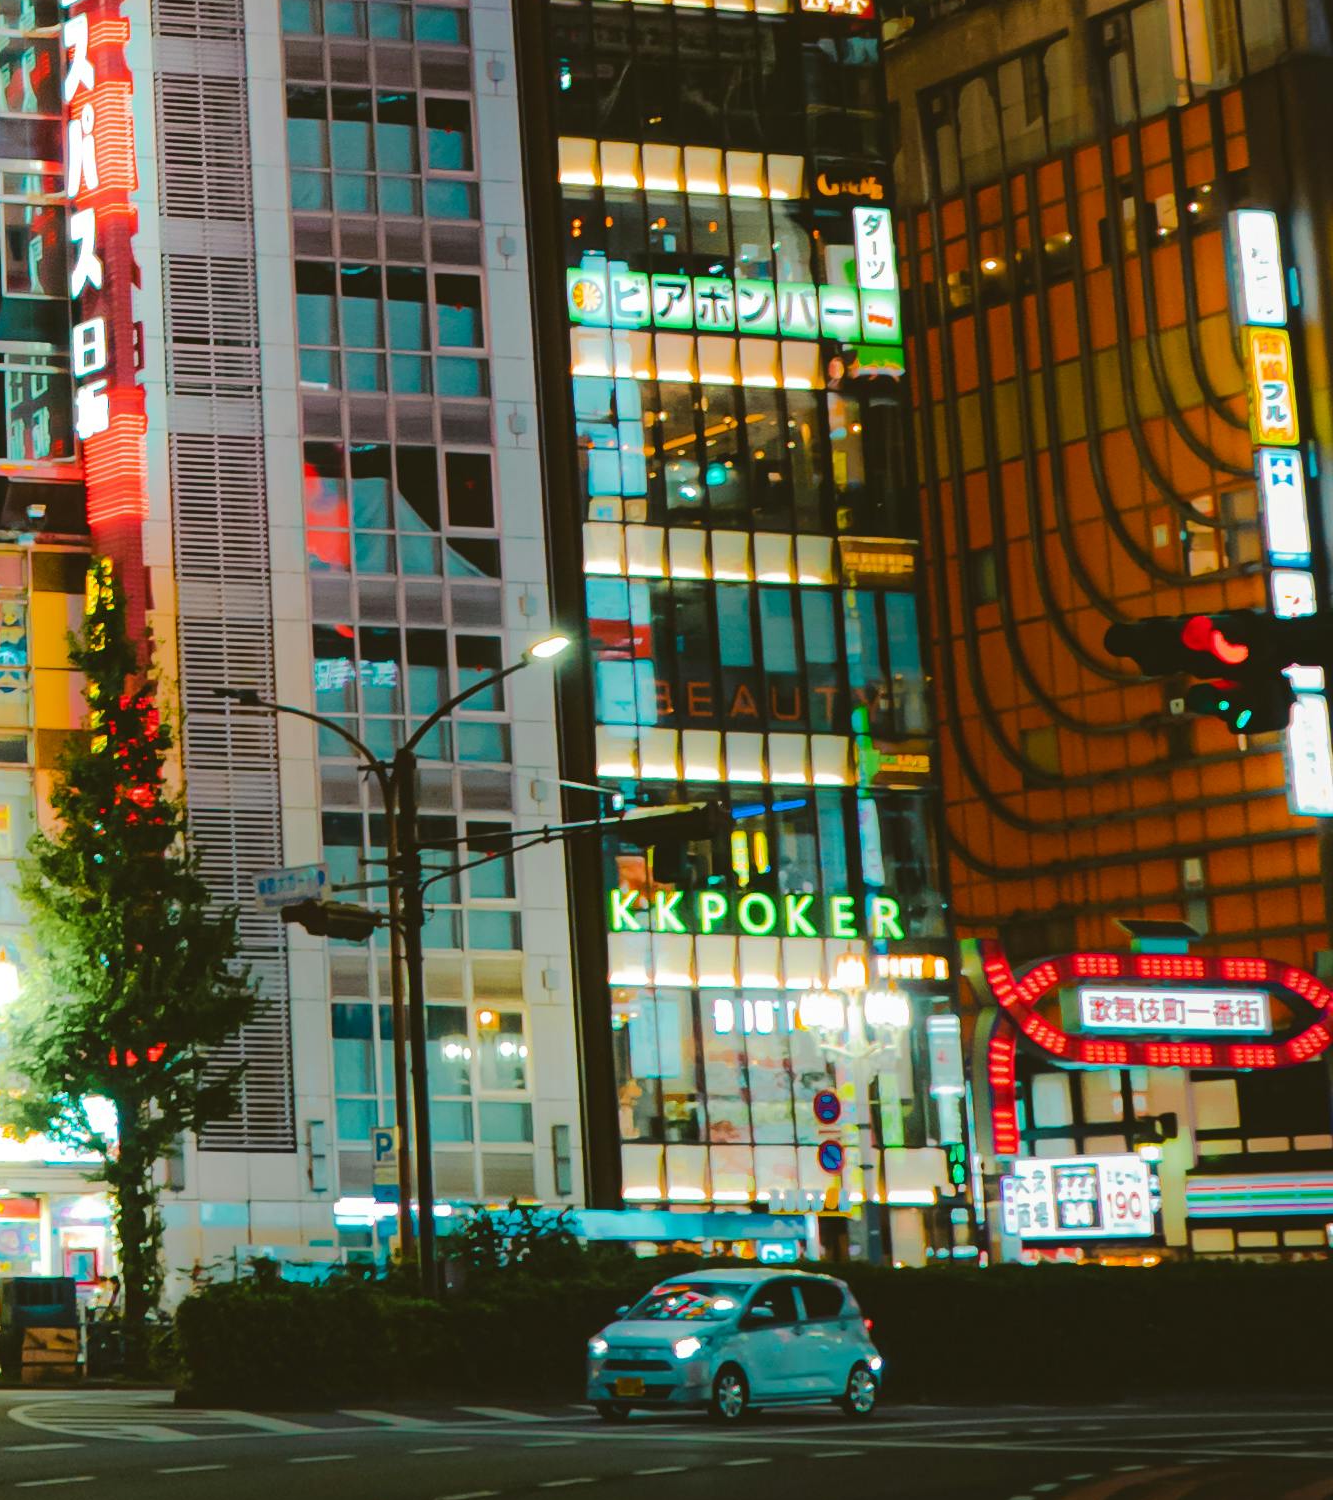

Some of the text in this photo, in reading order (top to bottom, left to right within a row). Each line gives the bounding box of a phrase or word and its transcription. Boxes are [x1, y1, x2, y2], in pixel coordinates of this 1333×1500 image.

[863, 213, 886, 280] ダーツ
[614, 279, 854, 331] ビアポンバー
[654, 680, 880, 722] BEAUTY
[609, 888, 904, 940] KKPOKER
[1090, 996, 1260, 1028] 歌舞伎町一番街
[376, 1133, 393, 1161] P
[1107, 1191, 1143, 1220] 190
